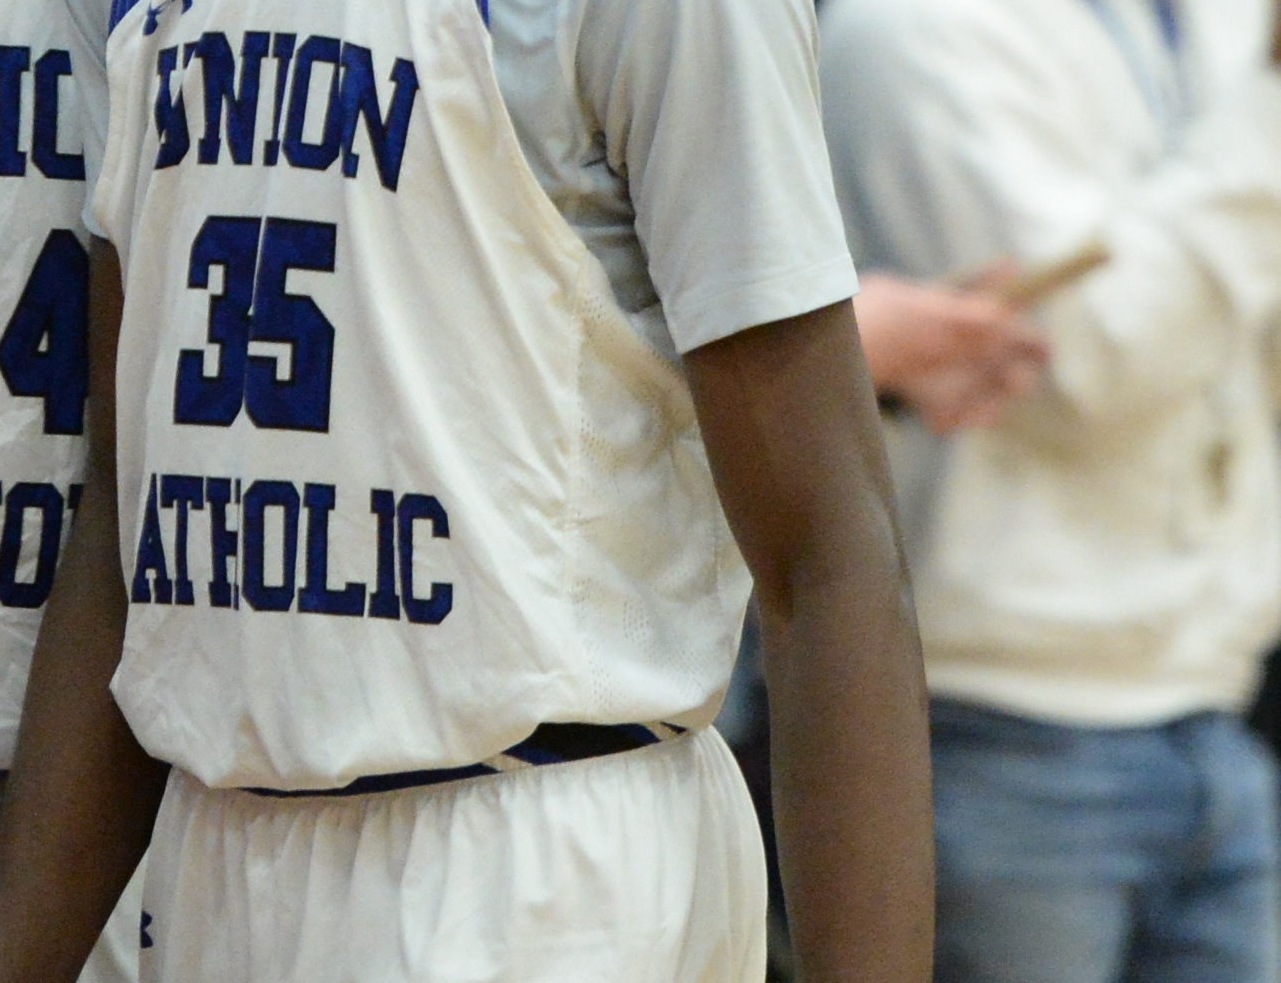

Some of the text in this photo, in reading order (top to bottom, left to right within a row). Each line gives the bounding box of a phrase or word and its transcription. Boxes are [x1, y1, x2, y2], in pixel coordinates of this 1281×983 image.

[155, 30, 420, 193] UNION
[173, 215, 337, 434] 35
[131, 473, 454, 626] ATHOLIC
